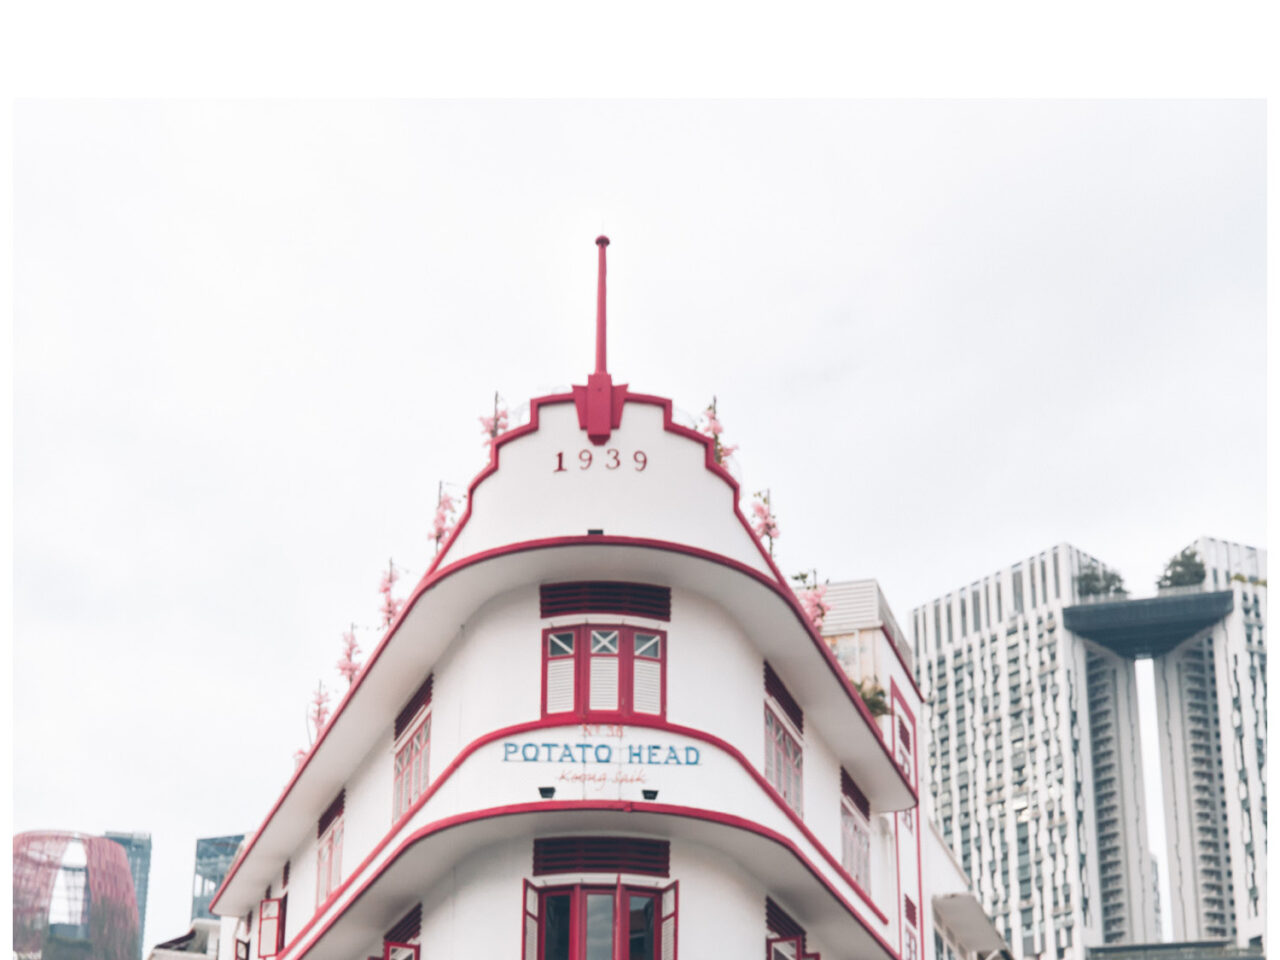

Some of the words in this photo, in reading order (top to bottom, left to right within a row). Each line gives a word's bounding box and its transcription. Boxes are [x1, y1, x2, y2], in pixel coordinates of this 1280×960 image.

[553, 448, 648, 473] 1939
[503, 742, 612, 763] POTATO
[628, 744, 701, 766] HEAD
